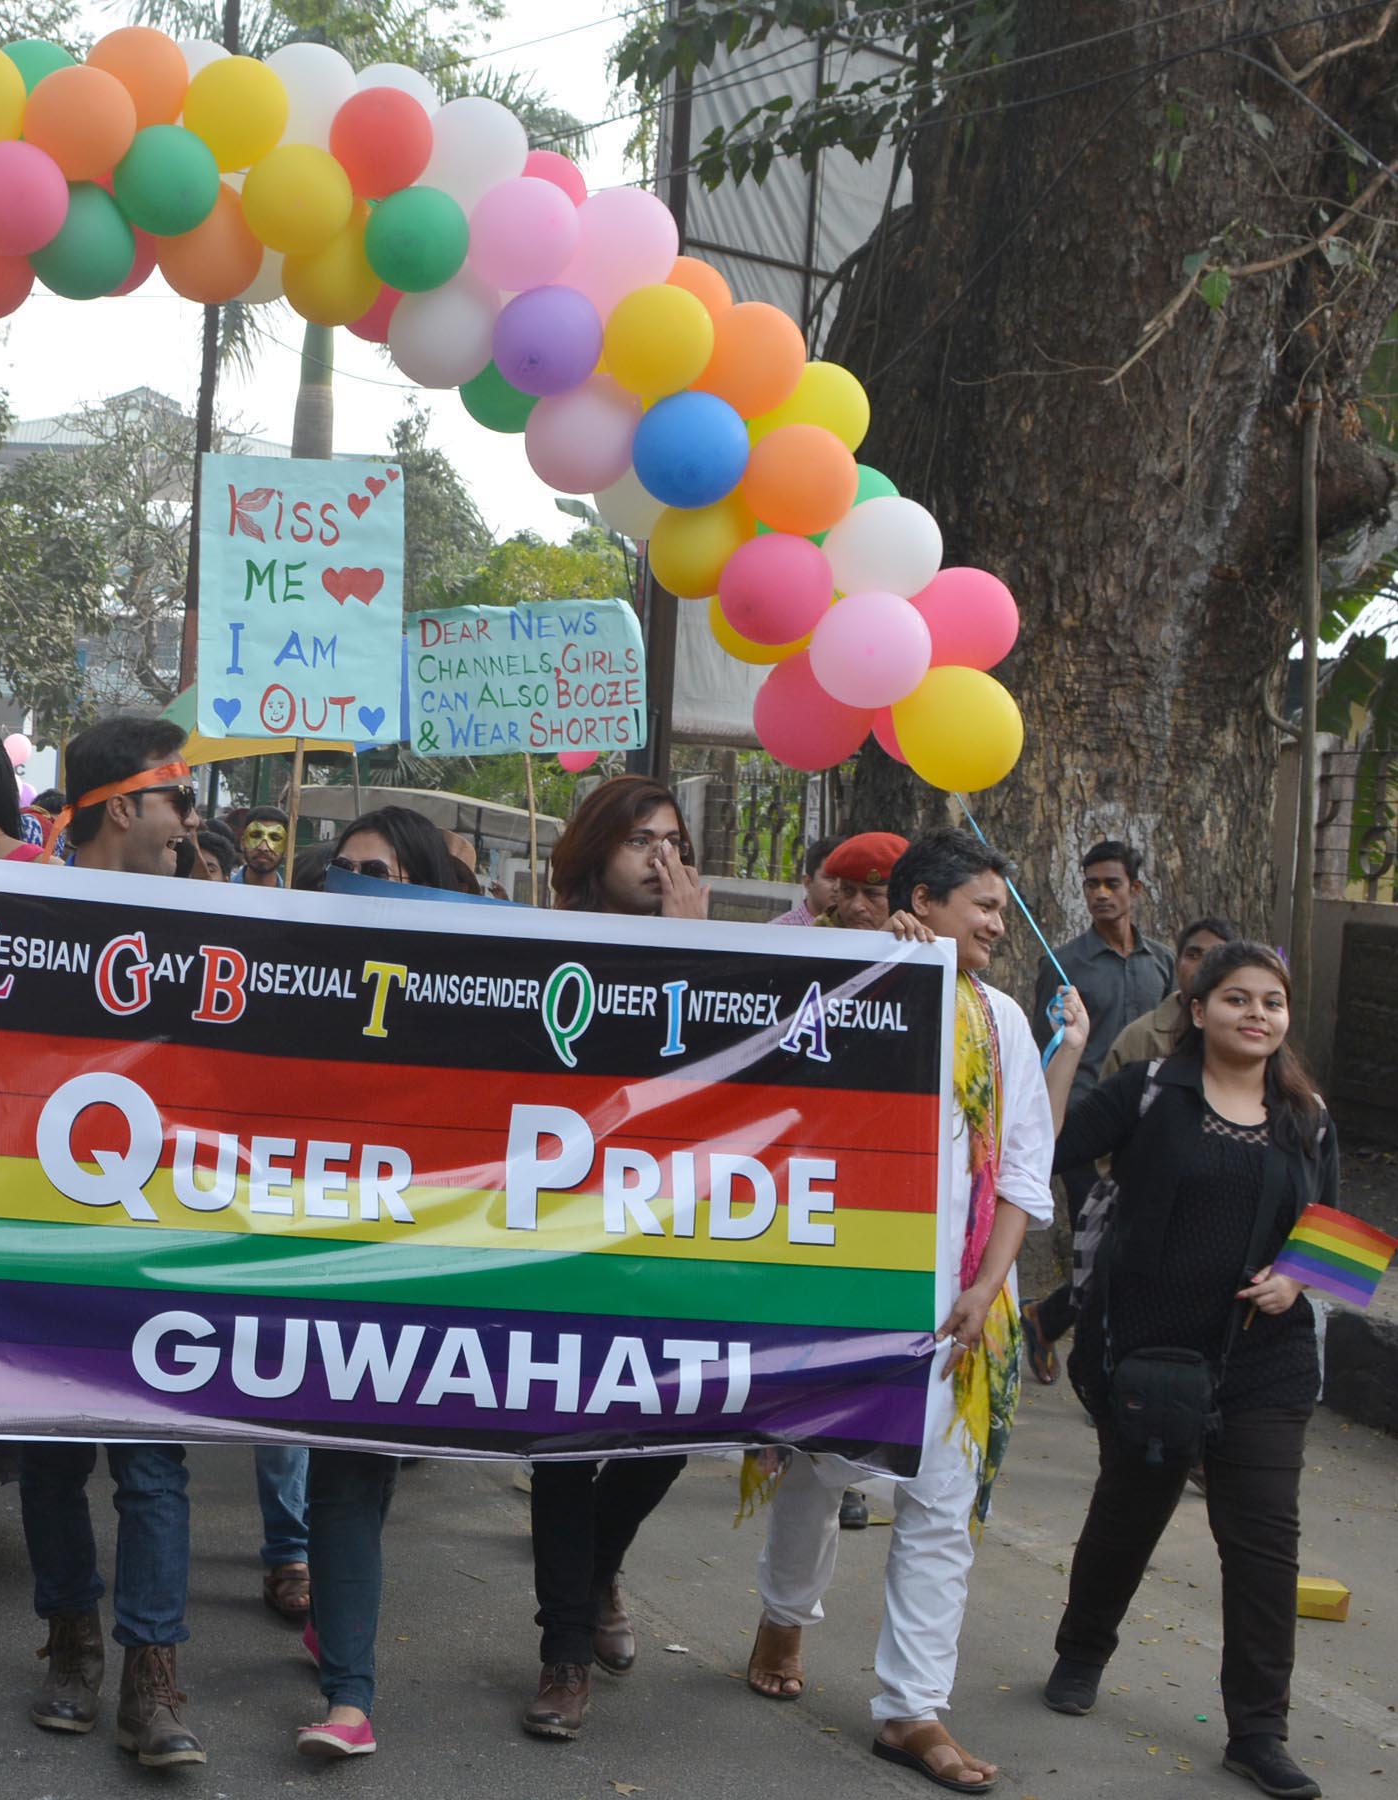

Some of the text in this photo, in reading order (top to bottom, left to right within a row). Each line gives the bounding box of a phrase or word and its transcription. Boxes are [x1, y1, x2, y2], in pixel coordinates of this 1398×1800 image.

[244, 559, 306, 603] ME
[226, 623, 337, 675] I AM
[418, 609, 597, 648] DEAR NEWS
[561, 643, 639, 673] GIRLS
[421, 678, 642, 713] CAN ALSO BOOZE
[417, 708, 642, 752] & WEAR SHORTS!
[95, 931, 194, 1016] GAY
[191, 945, 357, 1024] BISEXUAL
[361, 960, 539, 1038] TRANSGENDER
[542, 961, 656, 1067] QUEER
[660, 980, 781, 1057] INTERSEX
[780, 981, 908, 1062] ASEXUAL
[35, 1072, 837, 1245] QUEER PRIDE
[132, 1310, 753, 1416] GUWAHATI
